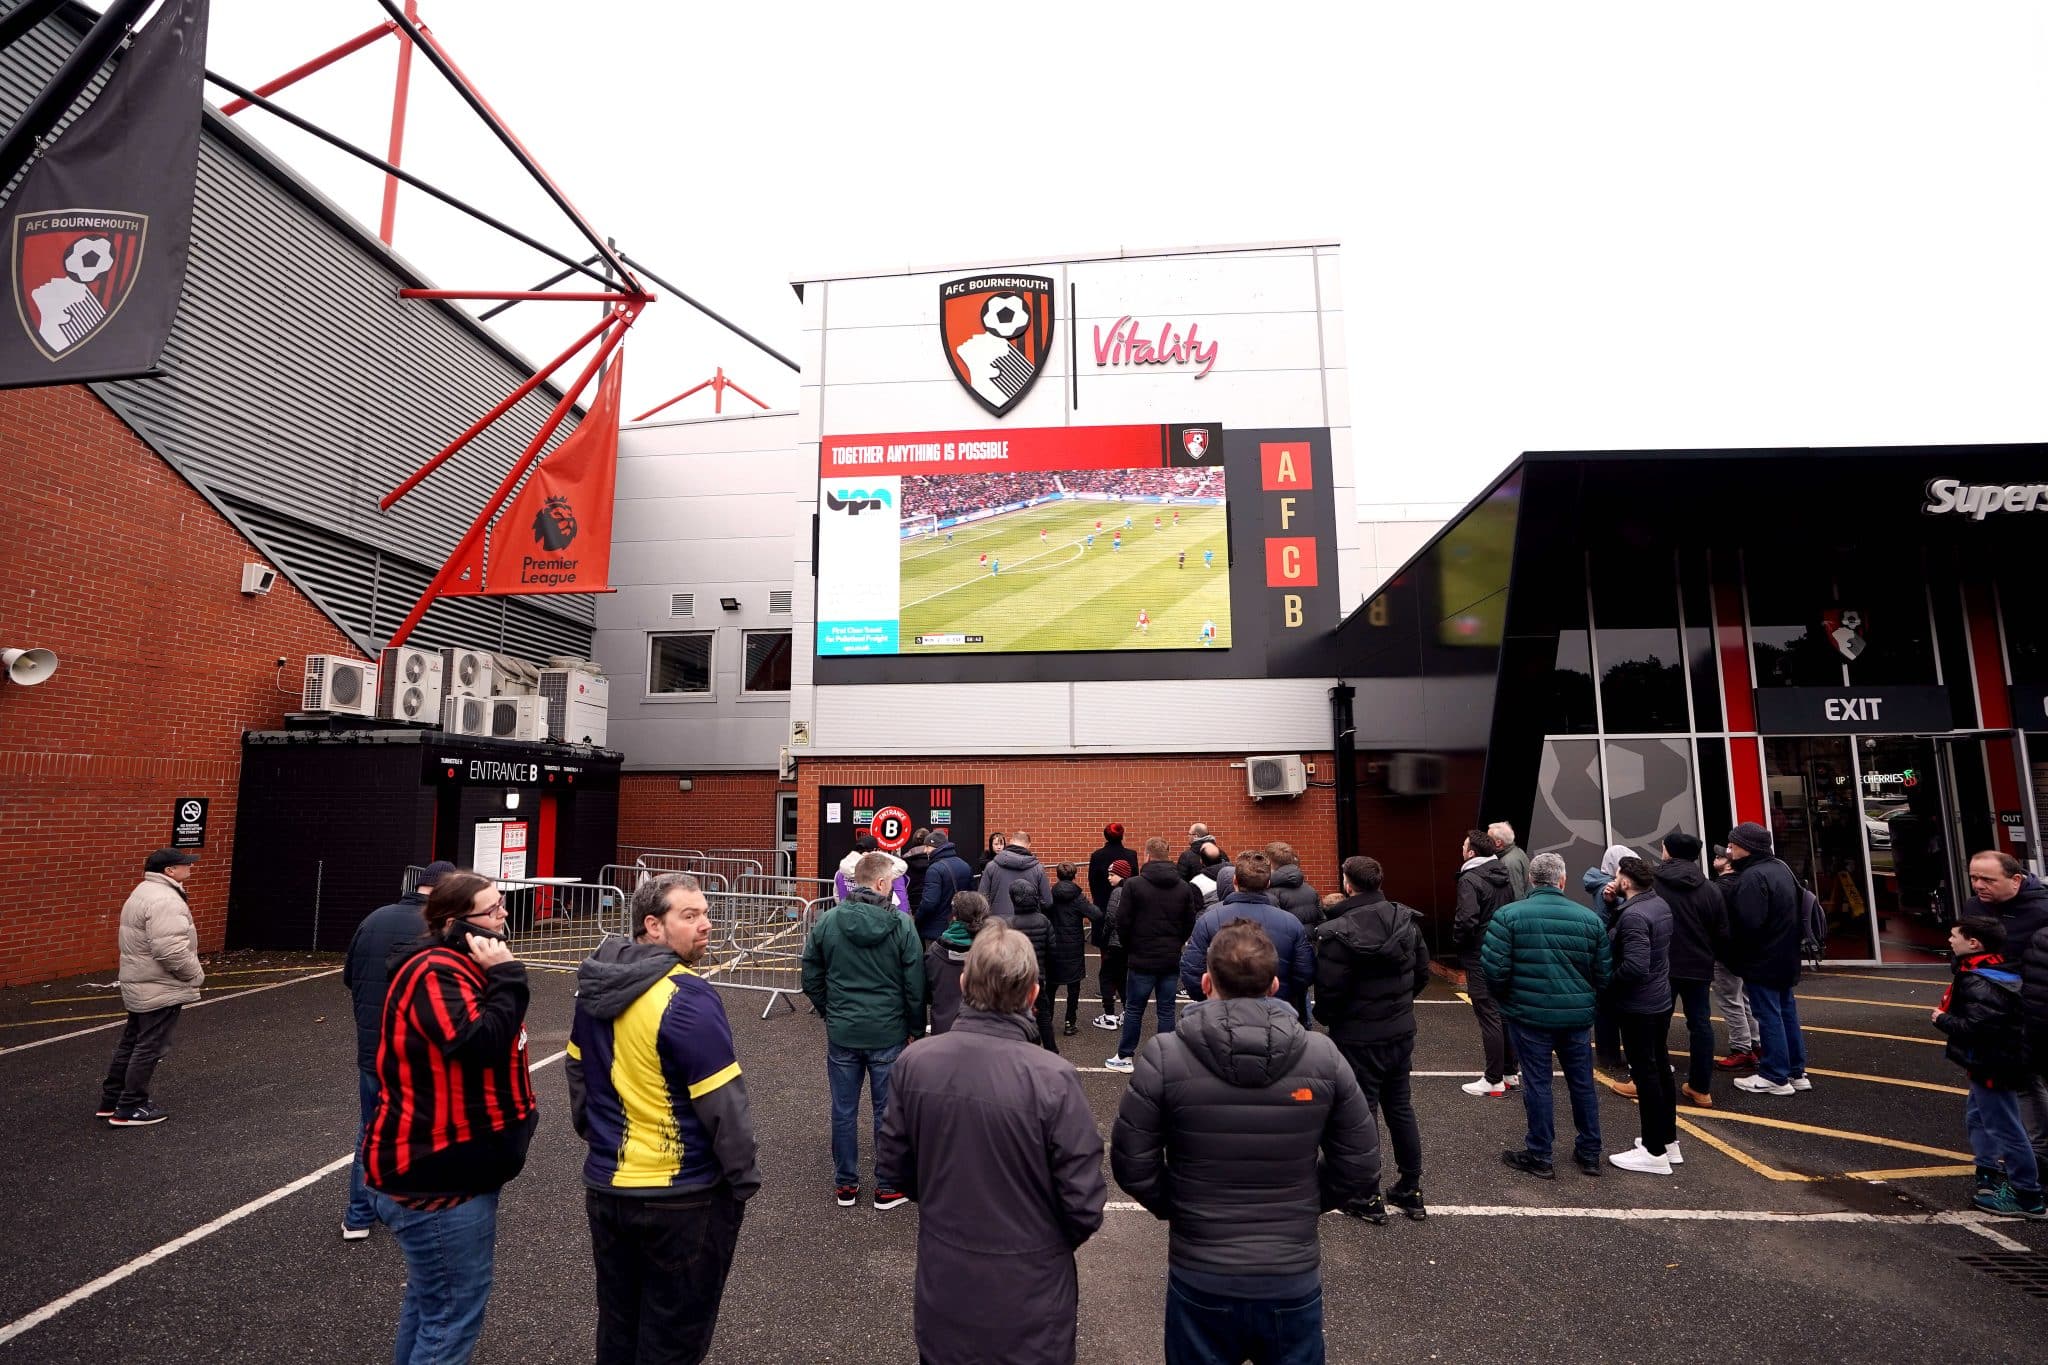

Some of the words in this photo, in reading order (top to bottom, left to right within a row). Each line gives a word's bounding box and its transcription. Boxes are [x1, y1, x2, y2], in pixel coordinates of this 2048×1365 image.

[25, 219, 49, 231] AFC
[51, 217, 139, 231] BOURNEMOUTH
[945, 283, 965, 296] AFC
[969, 278, 1049, 291] BOURNEMOUTH
[1093, 315, 1218, 380] Vitality
[832, 446, 884, 464] TOGETHER
[886, 443, 941, 463] ANYTHING
[944, 443, 955, 461] IS
[958, 441, 1009, 460] POSSIBLE
[523, 556, 579, 570] Premier
[521, 570, 577, 587] League
[1824, 698, 1883, 721] EXIT
[469, 760, 528, 782] ENTRANCE
[529, 764, 538, 782] B
[1835, 776, 1846, 785] UP
[1863, 773, 1904, 784] CHERRIES
[878, 809, 907, 820] ENTRANCE
[2001, 814, 2021, 823] OUT
[885, 819, 898, 838] B
